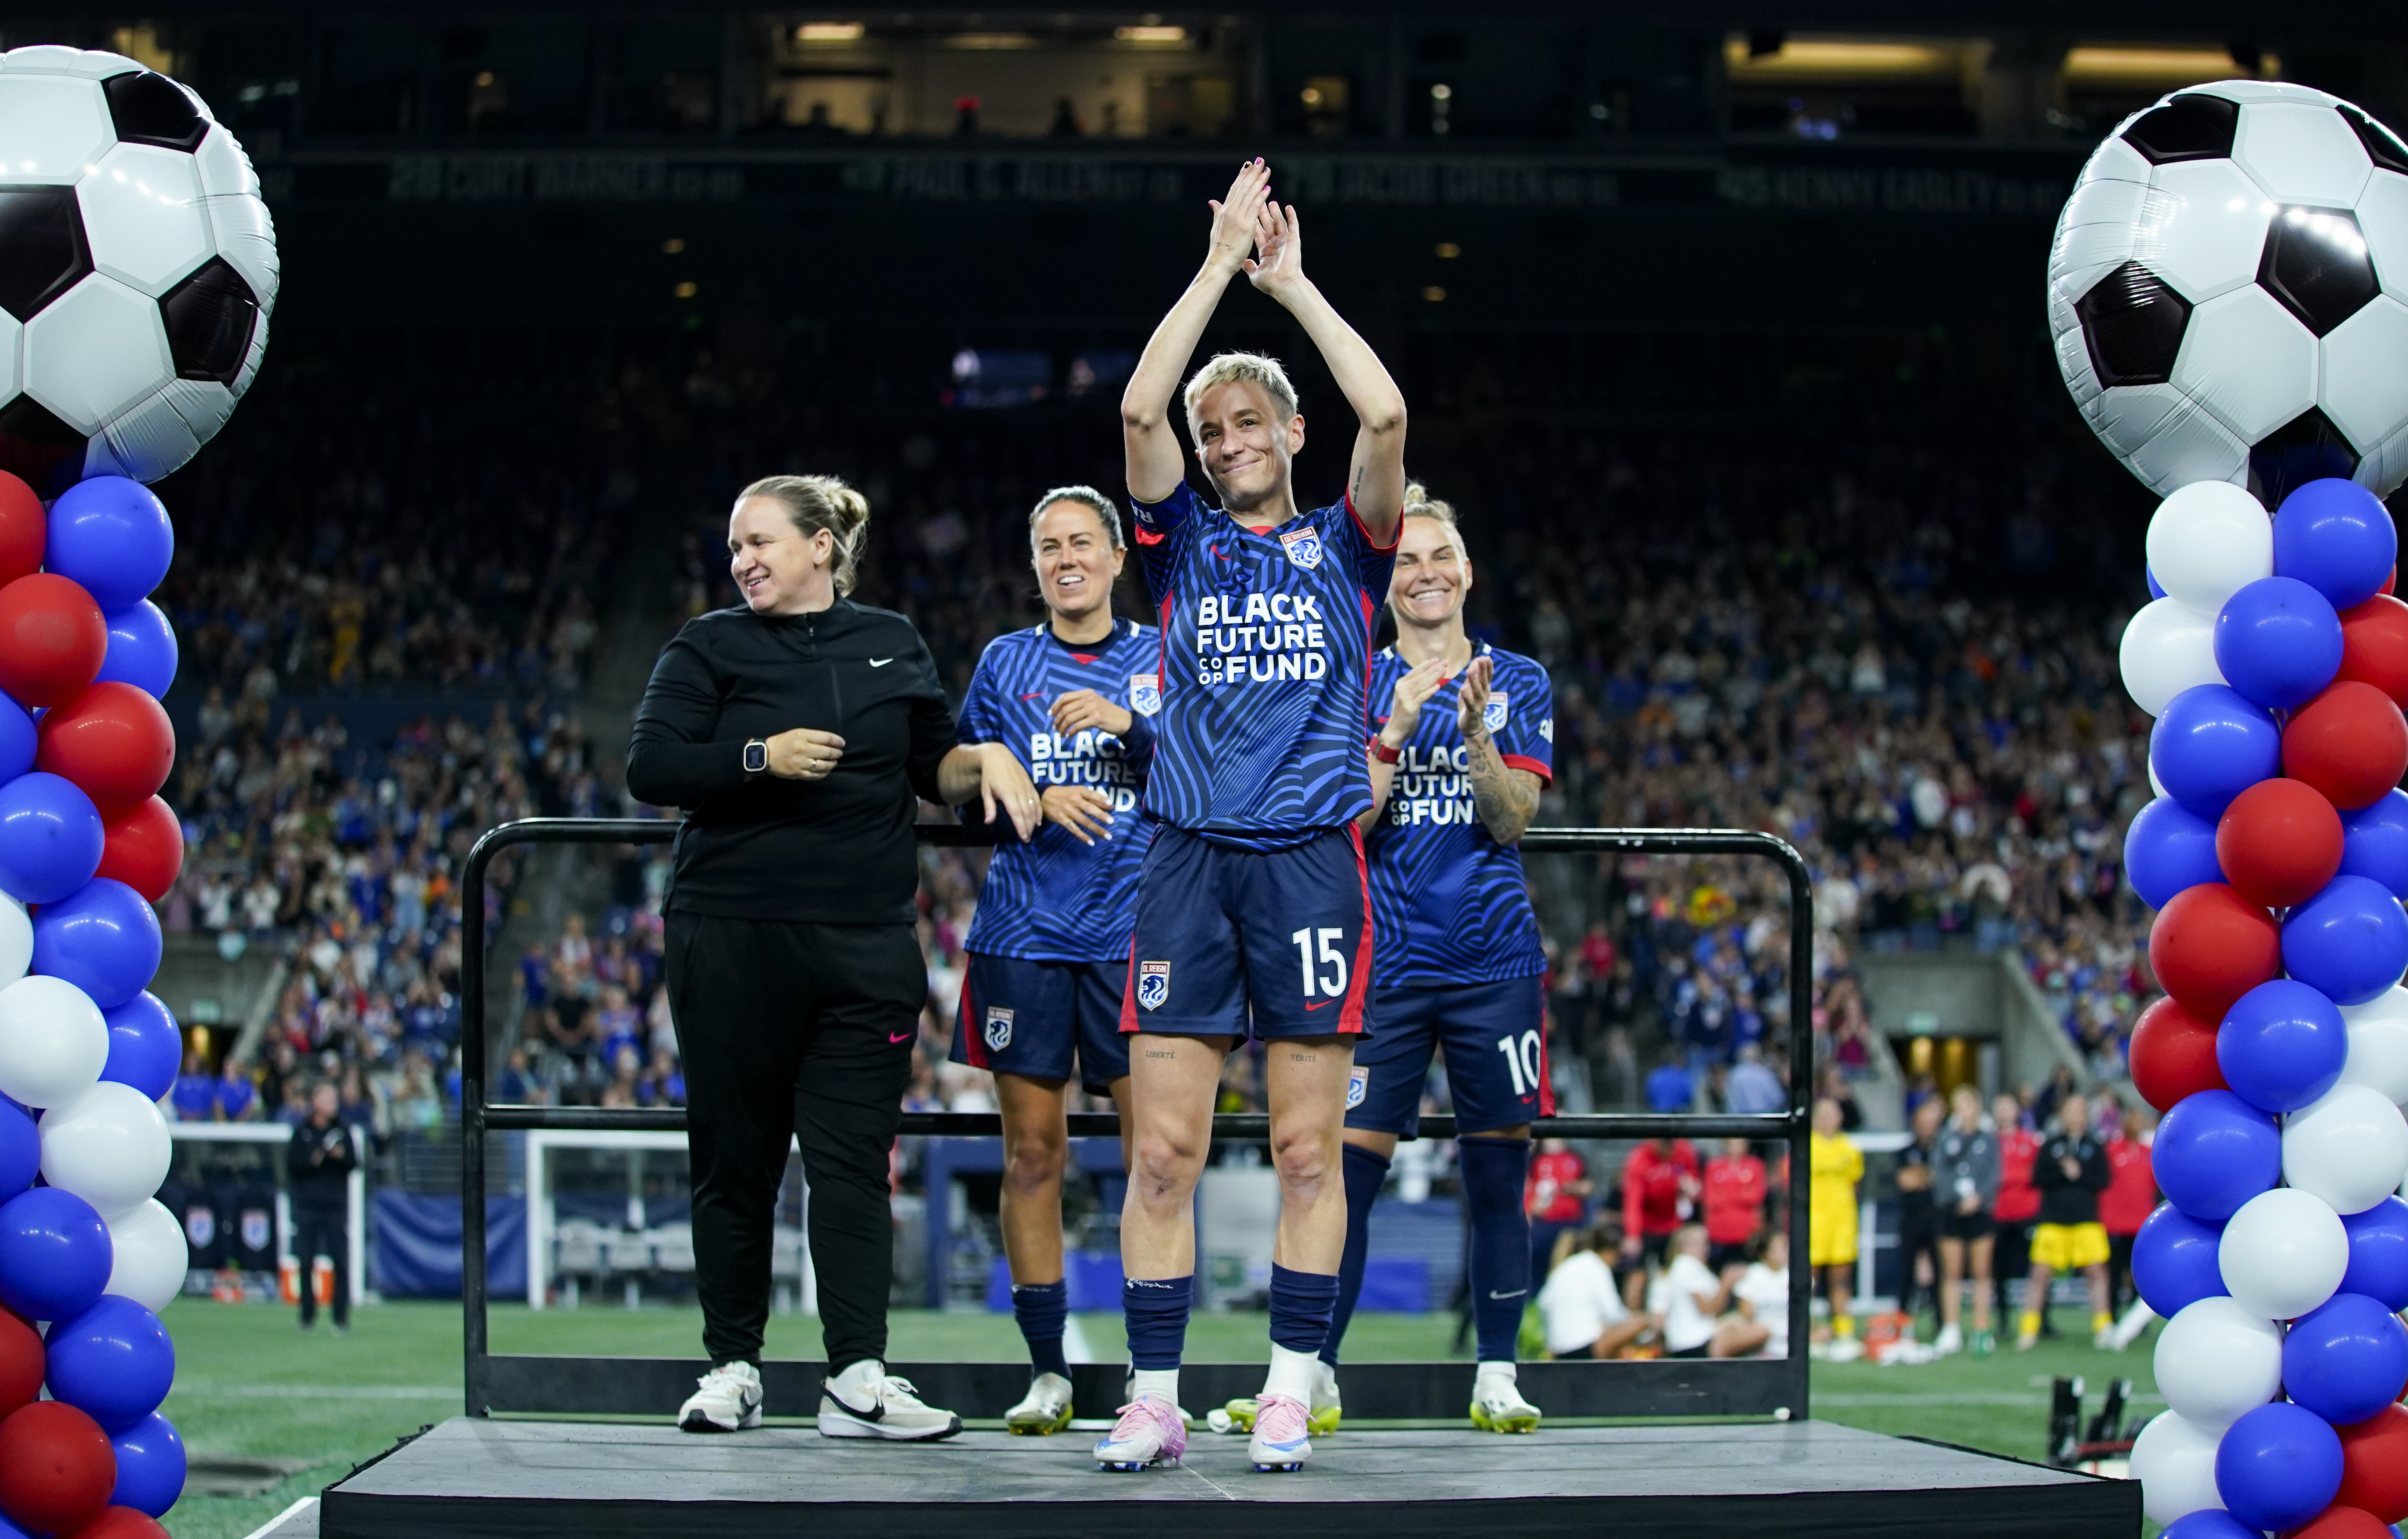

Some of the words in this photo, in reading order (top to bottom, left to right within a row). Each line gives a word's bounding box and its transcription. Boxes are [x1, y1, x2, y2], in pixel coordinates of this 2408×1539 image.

[1294, 529, 1313, 540] REIGN
[1198, 593, 1322, 626] BLACK
[1197, 624, 1325, 653] FUTURE
[1199, 657, 1222, 671] CO
[1226, 652, 1326, 683] FUND
[1199, 672, 1223, 685] OP
[1396, 745, 1469, 773] BLAC
[1032, 761, 1136, 784] FUTURE
[1389, 774, 1474, 798] FUTUR
[1390, 800, 1410, 812] CO
[1412, 799, 1474, 825] FUN
[1391, 814, 1411, 826] OP
[1293, 927, 1347, 997] 15
[1146, 1050, 1175, 1059] LIBERTÉ
[1291, 1053, 1317, 1062] VÉRITÉ
[1497, 1030, 1541, 1095] 10
